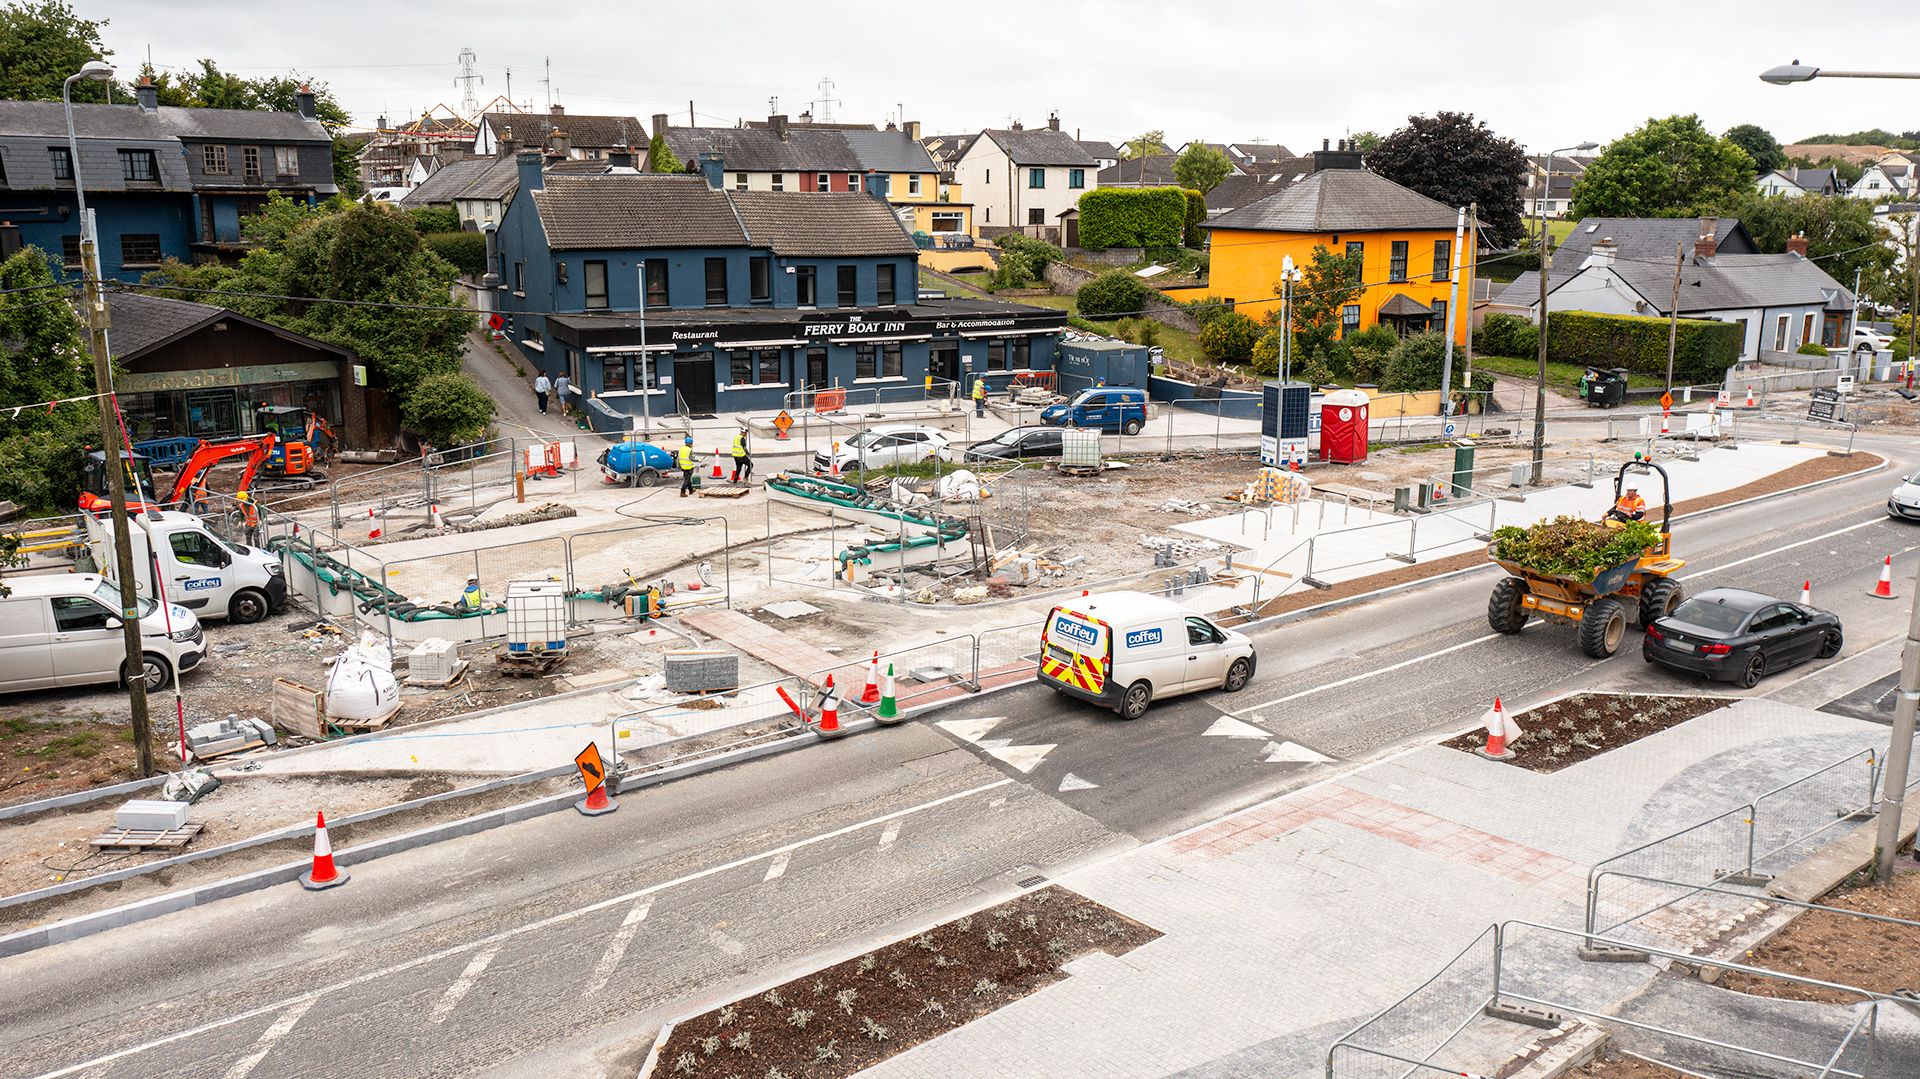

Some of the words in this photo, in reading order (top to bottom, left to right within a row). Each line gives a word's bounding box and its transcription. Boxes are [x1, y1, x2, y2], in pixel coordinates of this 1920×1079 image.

[804, 324, 844, 336] FERRY
[847, 322, 881, 334] BOAT
[883, 322, 905, 332] INN
[936, 321, 950, 329] Bar
[957, 319, 1015, 328] Accommodation
[671, 330, 718, 340] Restaurant
[187, 579, 220, 589] coffey
[1057, 620, 1096, 643] coffey
[1128, 630, 1160, 644] coffey
